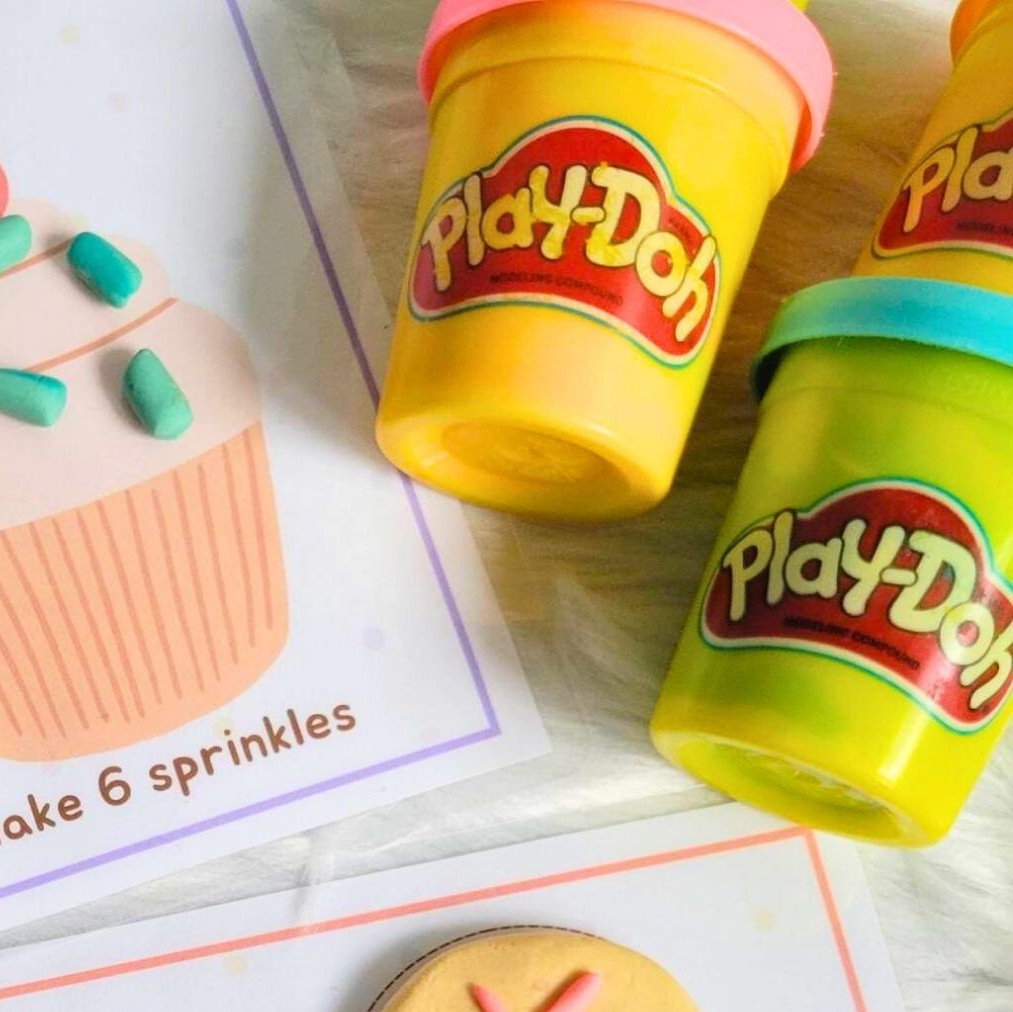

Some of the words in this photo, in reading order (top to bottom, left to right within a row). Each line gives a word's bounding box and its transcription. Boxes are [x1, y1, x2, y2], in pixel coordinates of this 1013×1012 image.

[420, 163, 718, 343] Play-Doh
[721, 509, 1013, 710] Play-Doh
[97, 765, 132, 807] 6
[149, 704, 356, 797] sprinkles
